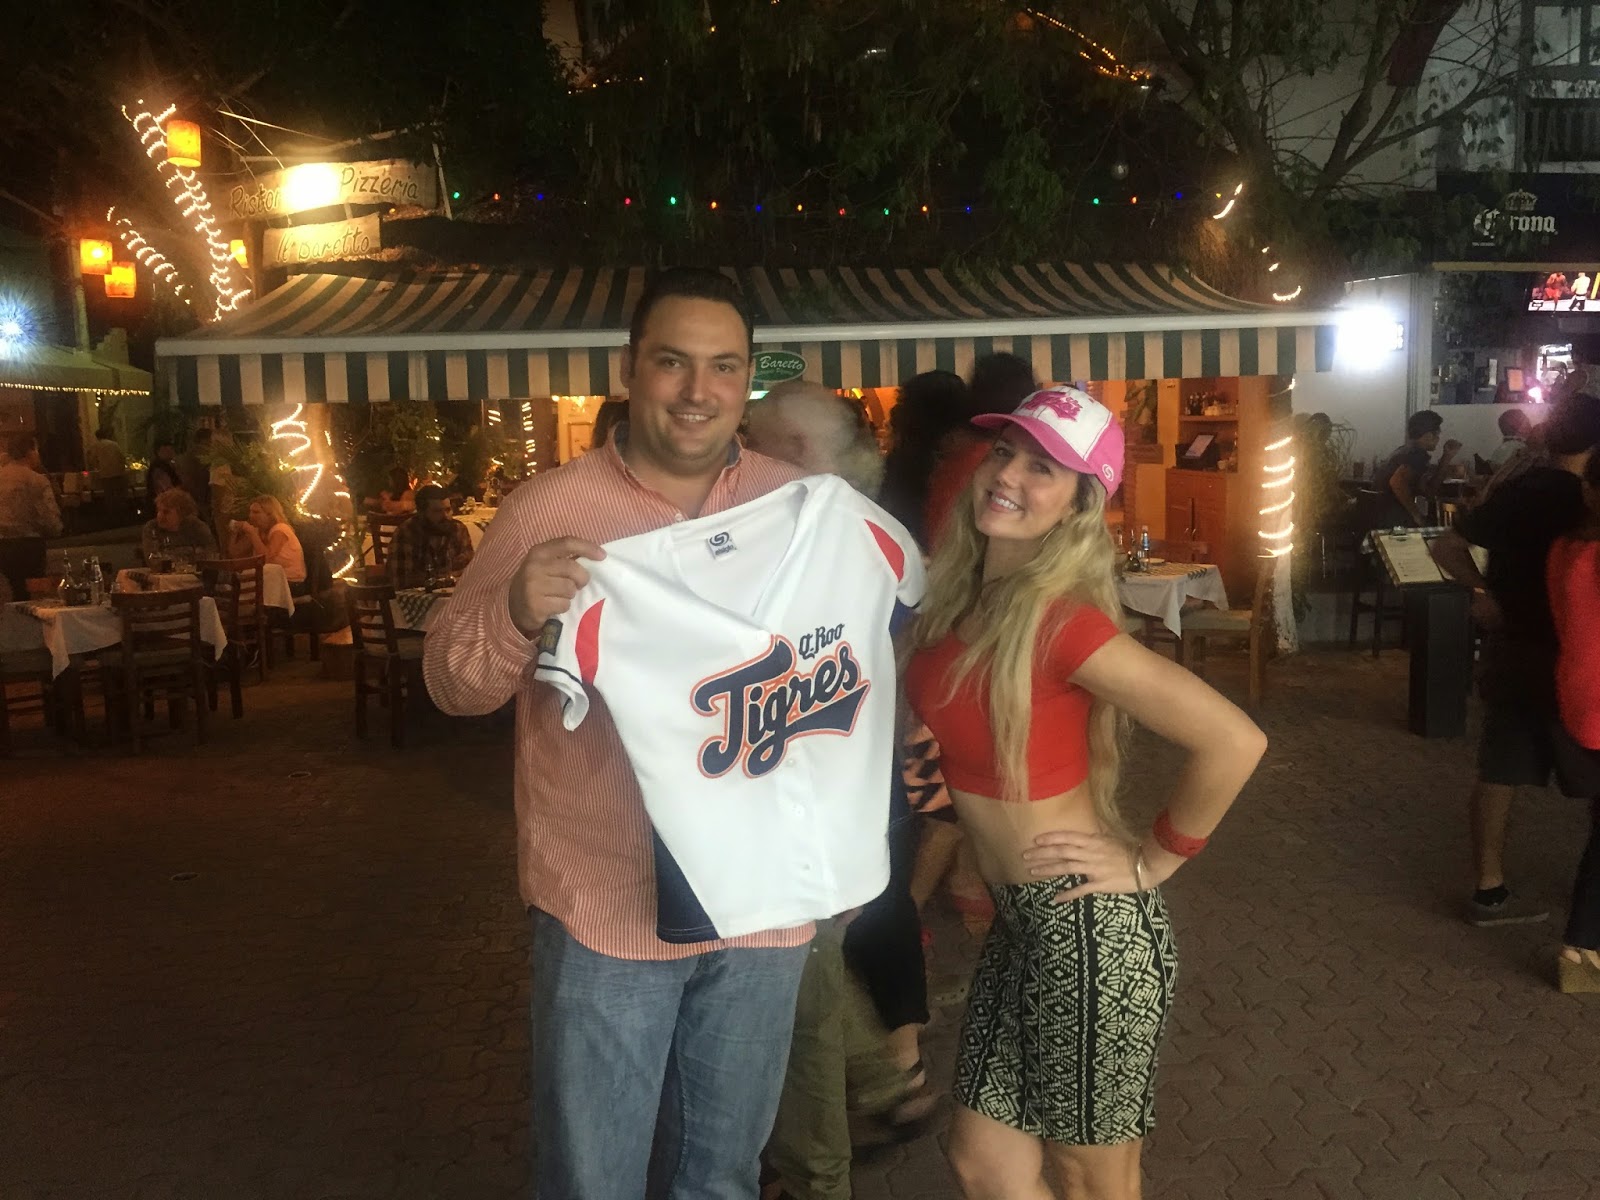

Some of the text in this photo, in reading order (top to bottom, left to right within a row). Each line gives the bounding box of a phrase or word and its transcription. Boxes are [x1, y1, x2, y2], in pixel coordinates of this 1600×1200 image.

[231, 184, 281, 218] Ristor
[1473, 209, 1556, 238] Crona
[760, 356, 803, 370] Baretto
[691, 634, 866, 779] Tigres
